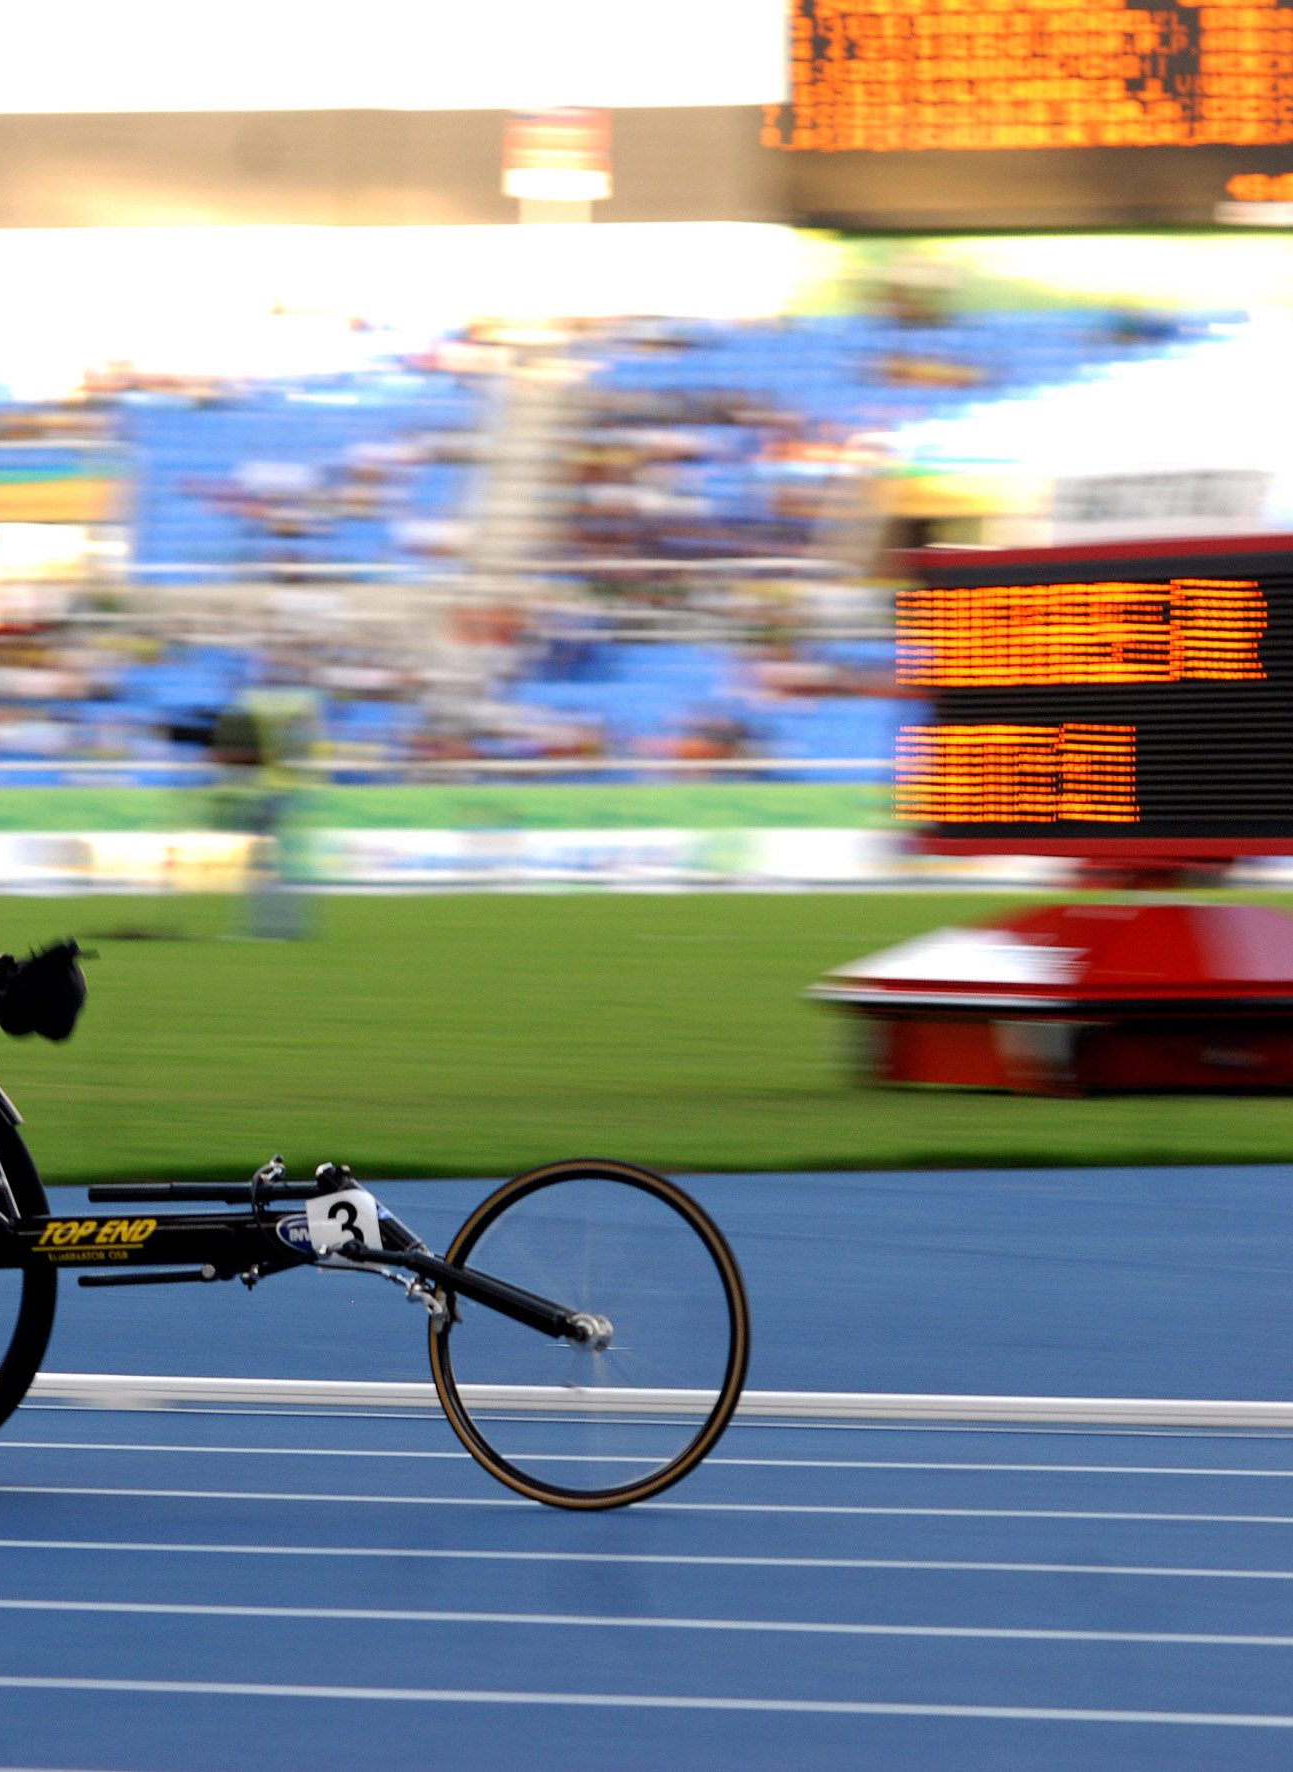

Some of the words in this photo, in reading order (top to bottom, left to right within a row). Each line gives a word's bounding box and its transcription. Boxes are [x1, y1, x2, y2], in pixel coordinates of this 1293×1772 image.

[38, 1219, 98, 1246] TOP
[94, 1218, 158, 1244] END
[328, 1201, 364, 1246] 3
